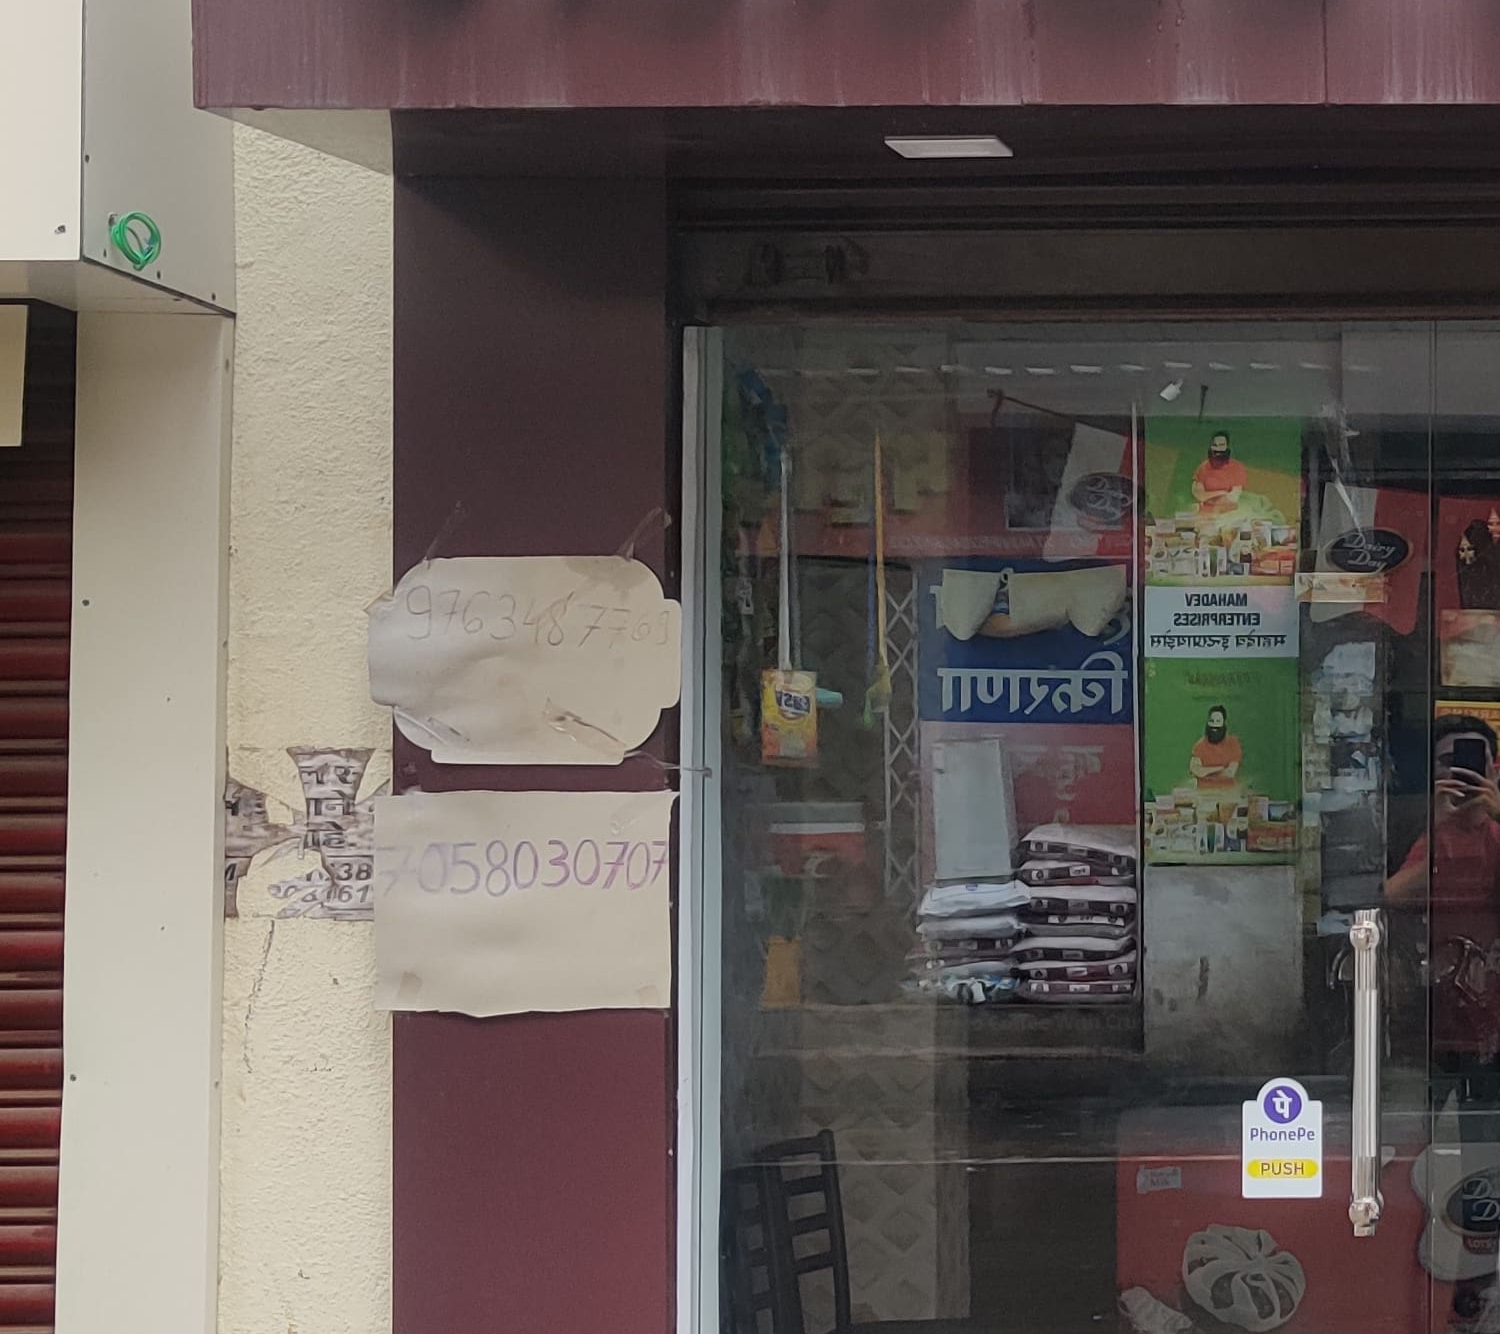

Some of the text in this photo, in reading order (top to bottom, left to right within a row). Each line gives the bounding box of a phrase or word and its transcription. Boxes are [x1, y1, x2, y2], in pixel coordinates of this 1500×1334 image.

[1343, 532, 1396, 558] Dairy
[1347, 548, 1388, 575] Day
[1250, 1127, 1315, 1142] PhonePe
[1261, 1162, 1305, 1175] PUSH
